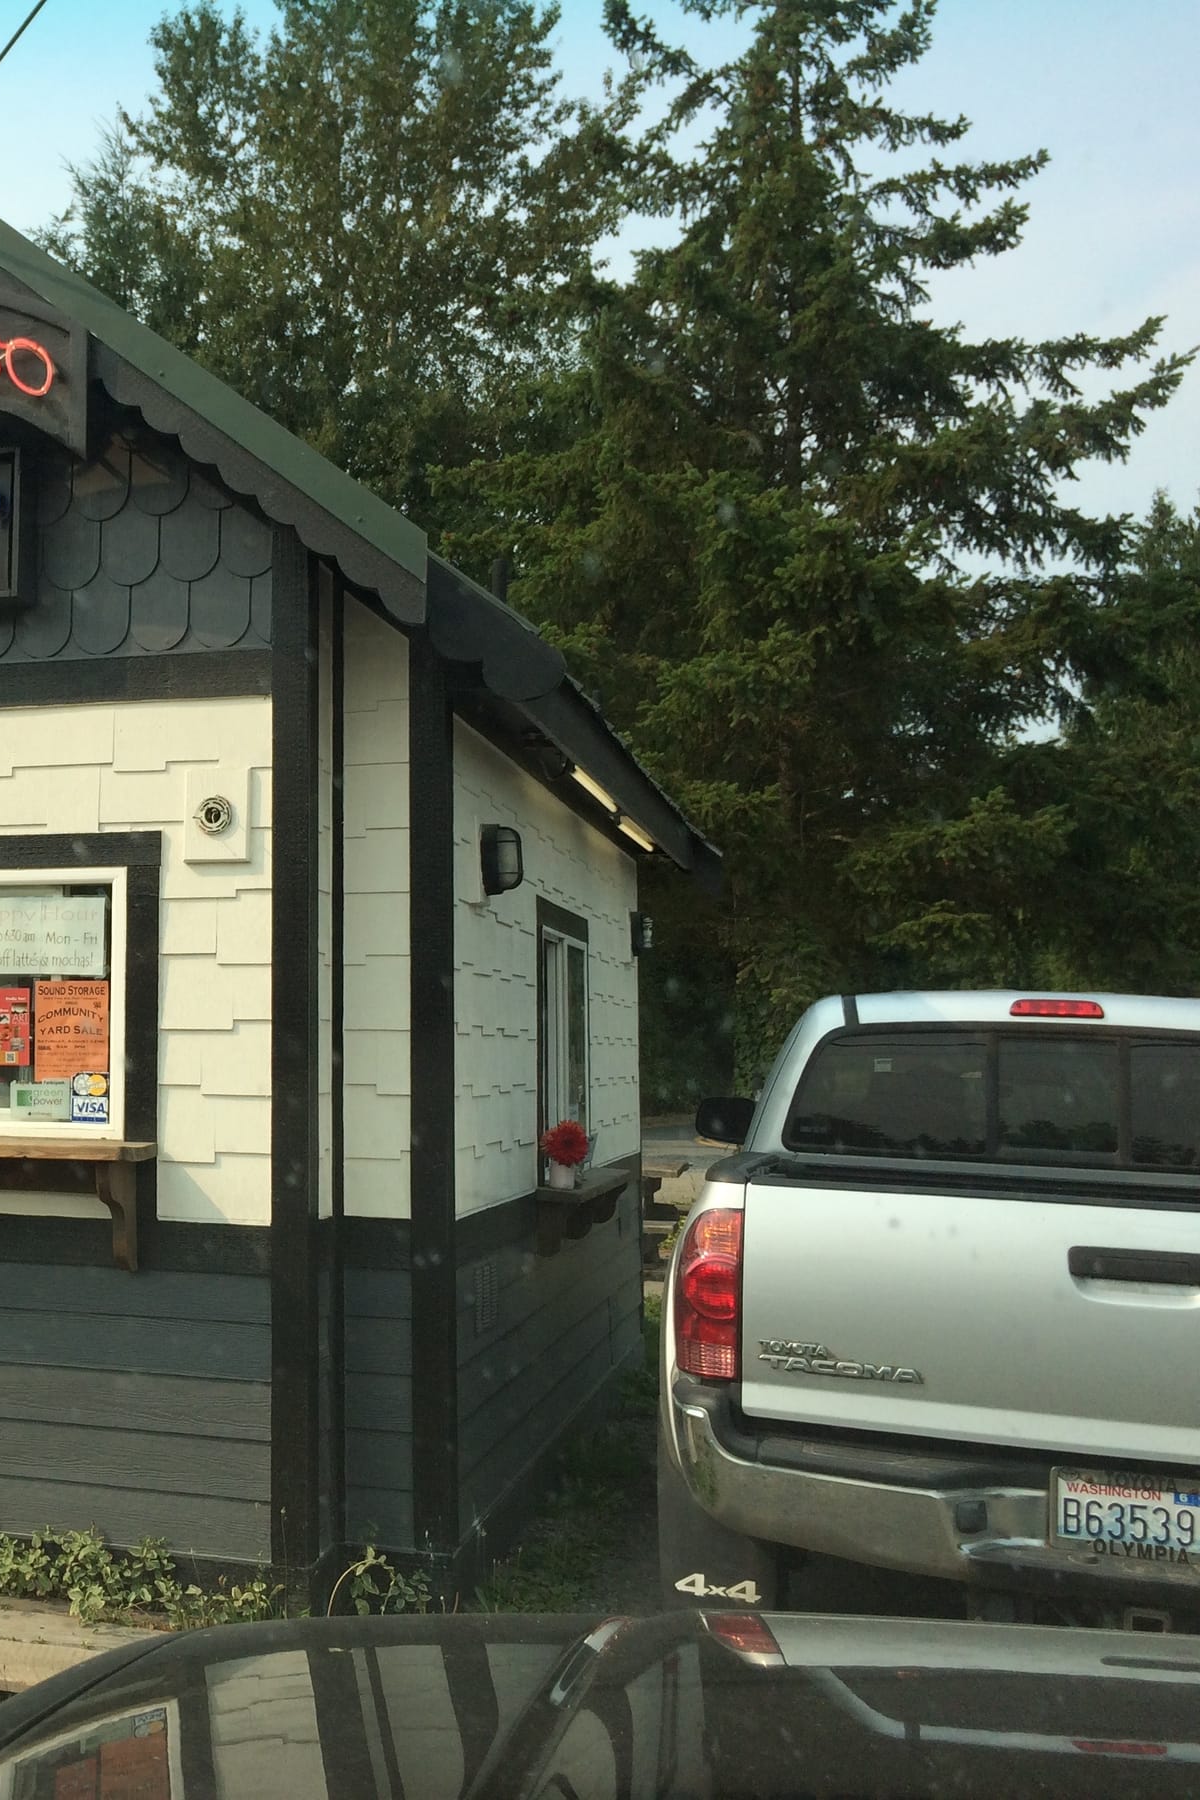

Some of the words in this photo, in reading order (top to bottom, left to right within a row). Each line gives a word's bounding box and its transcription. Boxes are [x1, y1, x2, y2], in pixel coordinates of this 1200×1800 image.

[43, 904, 98, 922] Hour
[45, 931, 71, 945] Mon
[83, 931, 98, 945] Fri
[37, 985, 66, 996] SOUND
[68, 985, 106, 996] STORAGE
[37, 1006, 104, 1024] COMMUNITY
[39, 1025, 71, 1036] YARD
[73, 1025, 104, 1036] SALE
[32, 1088, 64, 1099] green
[32, 1097, 63, 1106] power
[77, 1102, 106, 1114] VISA
[758, 1338, 829, 1358] TOYOTA
[758, 1353, 925, 1385] TACOMA
[1065, 1481, 1163, 1502] WASHINGTON
[1093, 1537, 1190, 1565] OLYMPIA
[674, 1573, 762, 1604] 4x4
